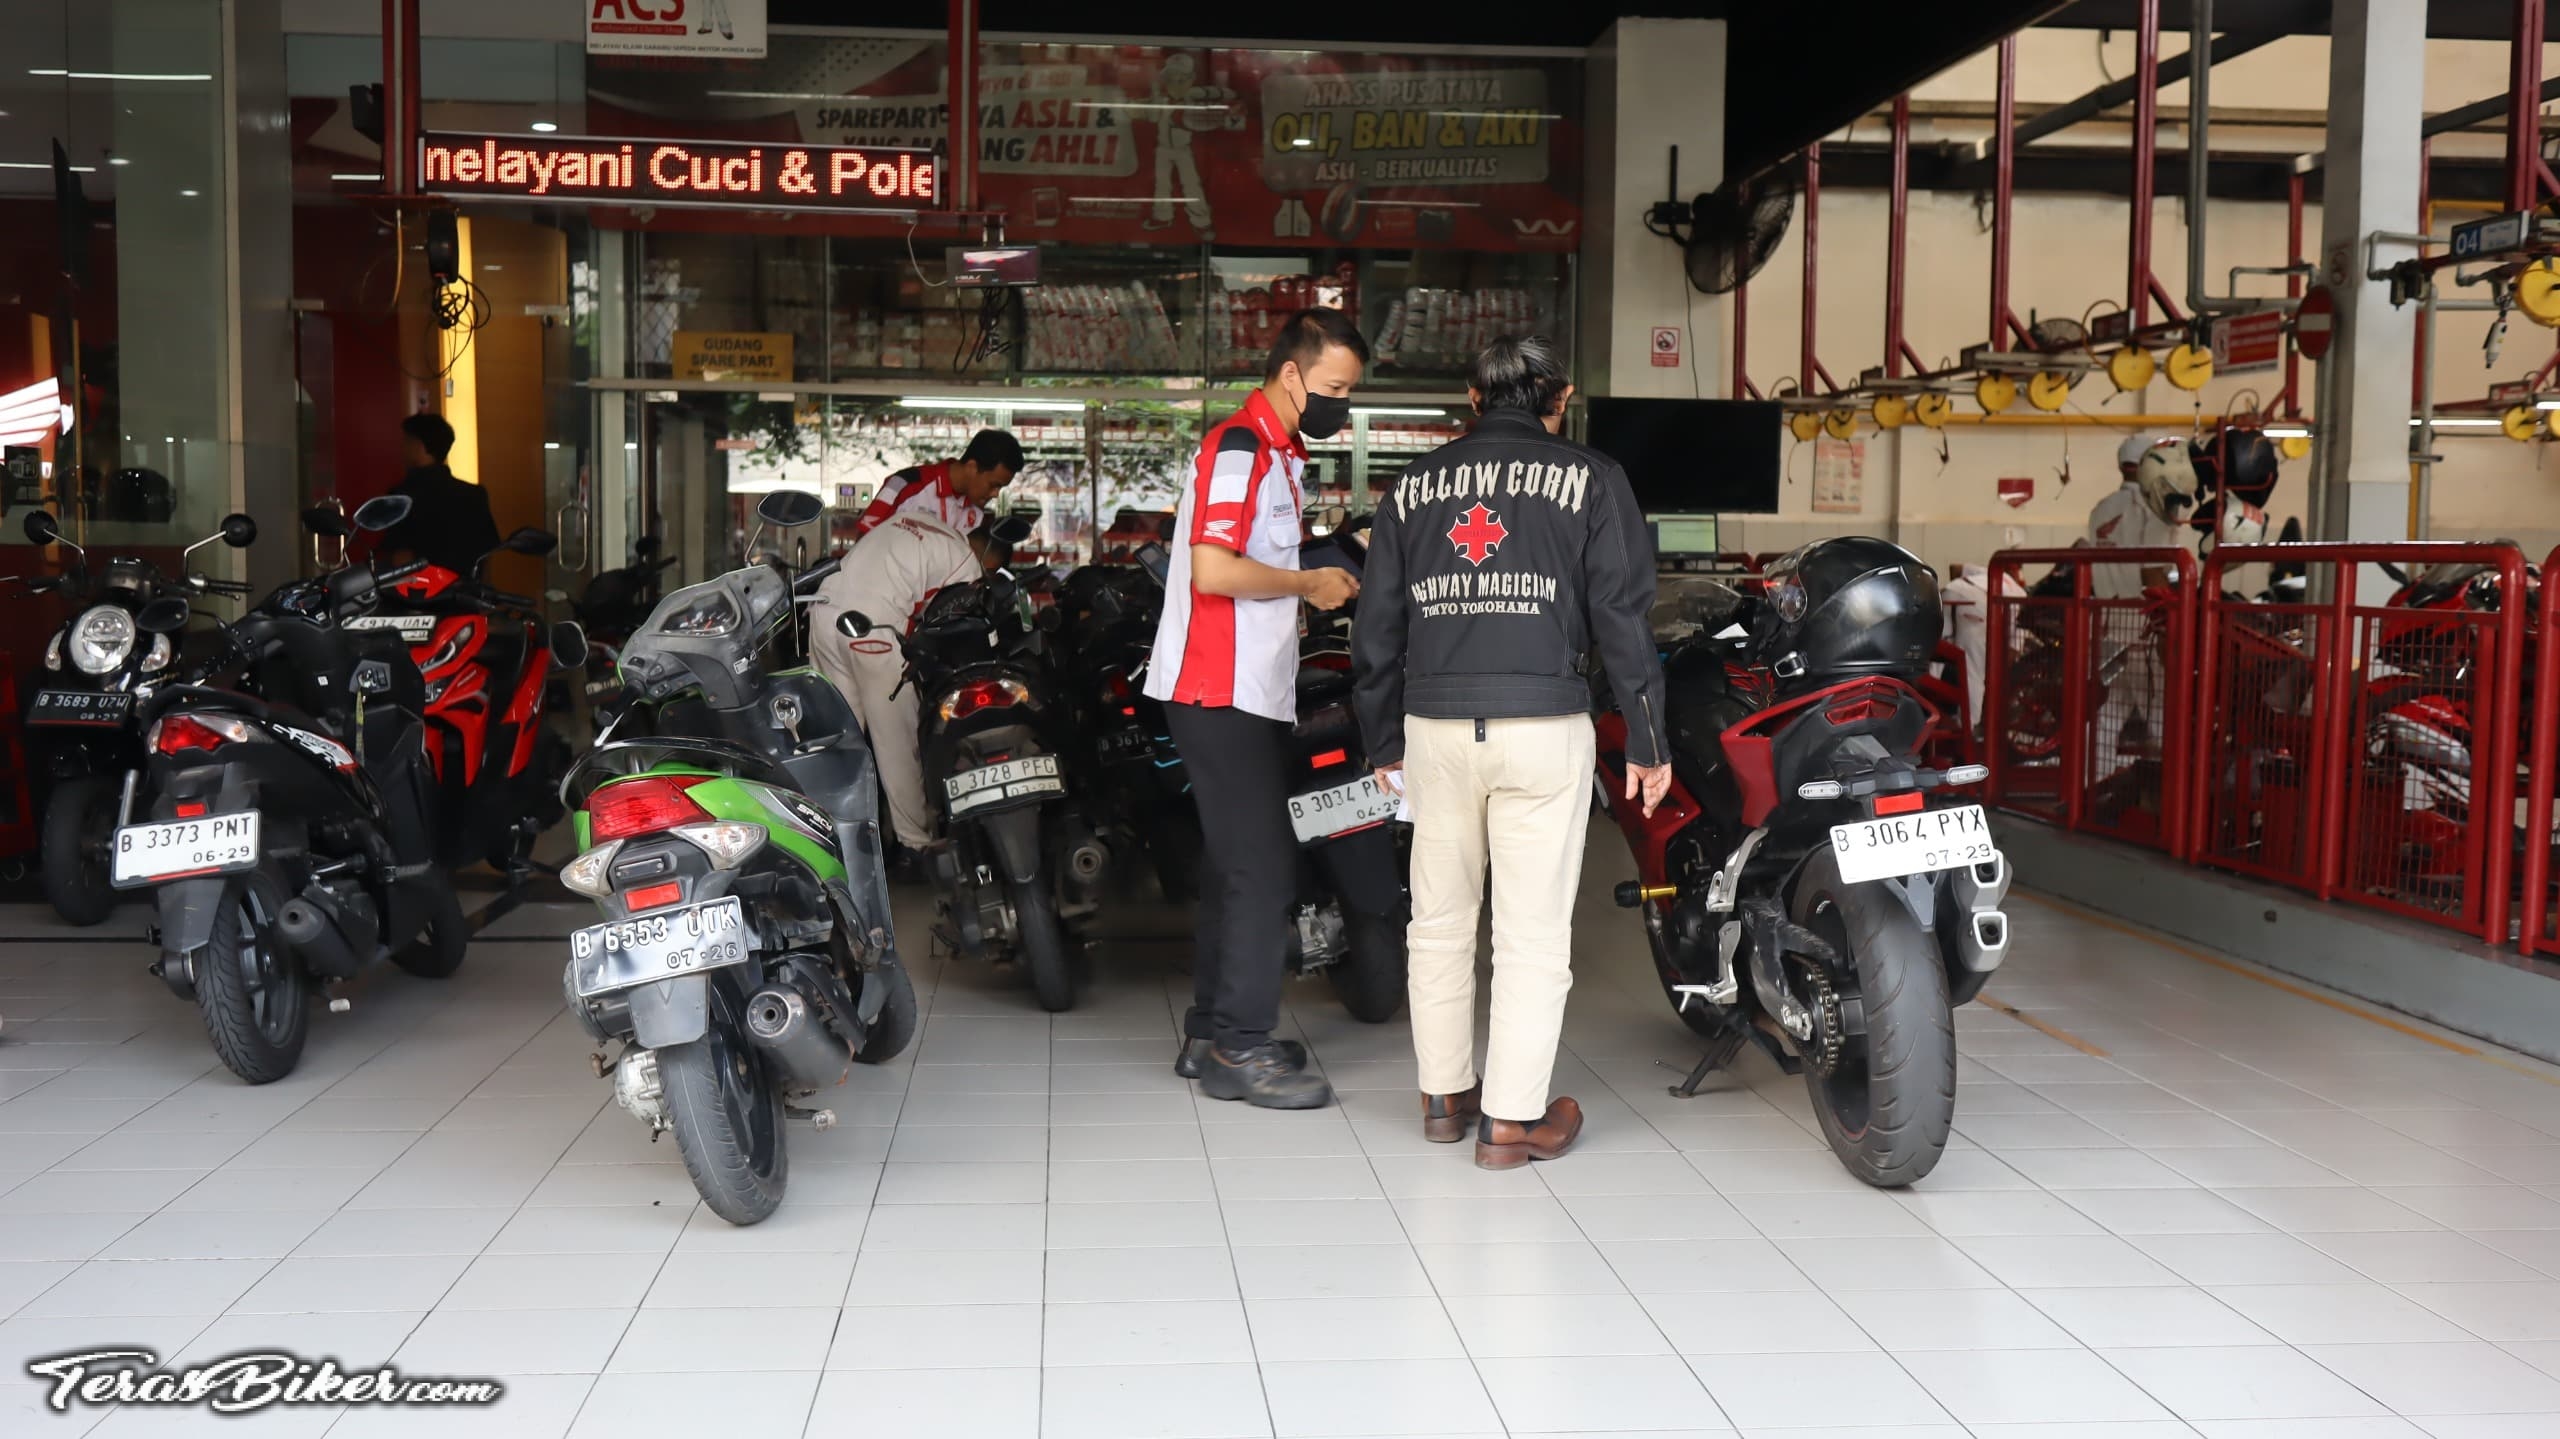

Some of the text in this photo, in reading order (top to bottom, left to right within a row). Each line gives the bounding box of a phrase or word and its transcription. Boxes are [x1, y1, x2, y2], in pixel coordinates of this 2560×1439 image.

[1011, 99, 1093, 130] ASLI
[1096, 106, 1116, 129] &
[1352, 109, 1429, 150] BAN
[1439, 108, 1466, 147] &
[1476, 107, 1541, 147] AKI
[1029, 135, 1120, 165] AHLI
[649, 145, 761, 192] Cuci
[777, 150, 817, 194] &
[830, 152, 933, 198] Pole
[1315, 161, 1355, 181] ASLI
[1375, 158, 1498, 180] BERKUALITAS
[2456, 229, 2479, 255] 04
[704, 337, 763, 351] GUDANG
[691, 353, 776, 368] SPARE PART
[1394, 458, 1590, 524] YELLOW CORN
[1477, 571, 1557, 603] MAGICIAN
[1422, 600, 1541, 618] TOKYO YOKOHAMA
[40, 694, 50, 707] B
[54, 696, 91, 708] 3689
[949, 779, 960, 797] B
[968, 764, 1012, 790] 3728
[1291, 801, 1305, 819] B
[121, 816, 252, 853] B 3373 PNT
[1835, 807, 1985, 852] B 3064 PYX
[574, 902, 738, 961] B 6553 UTK
